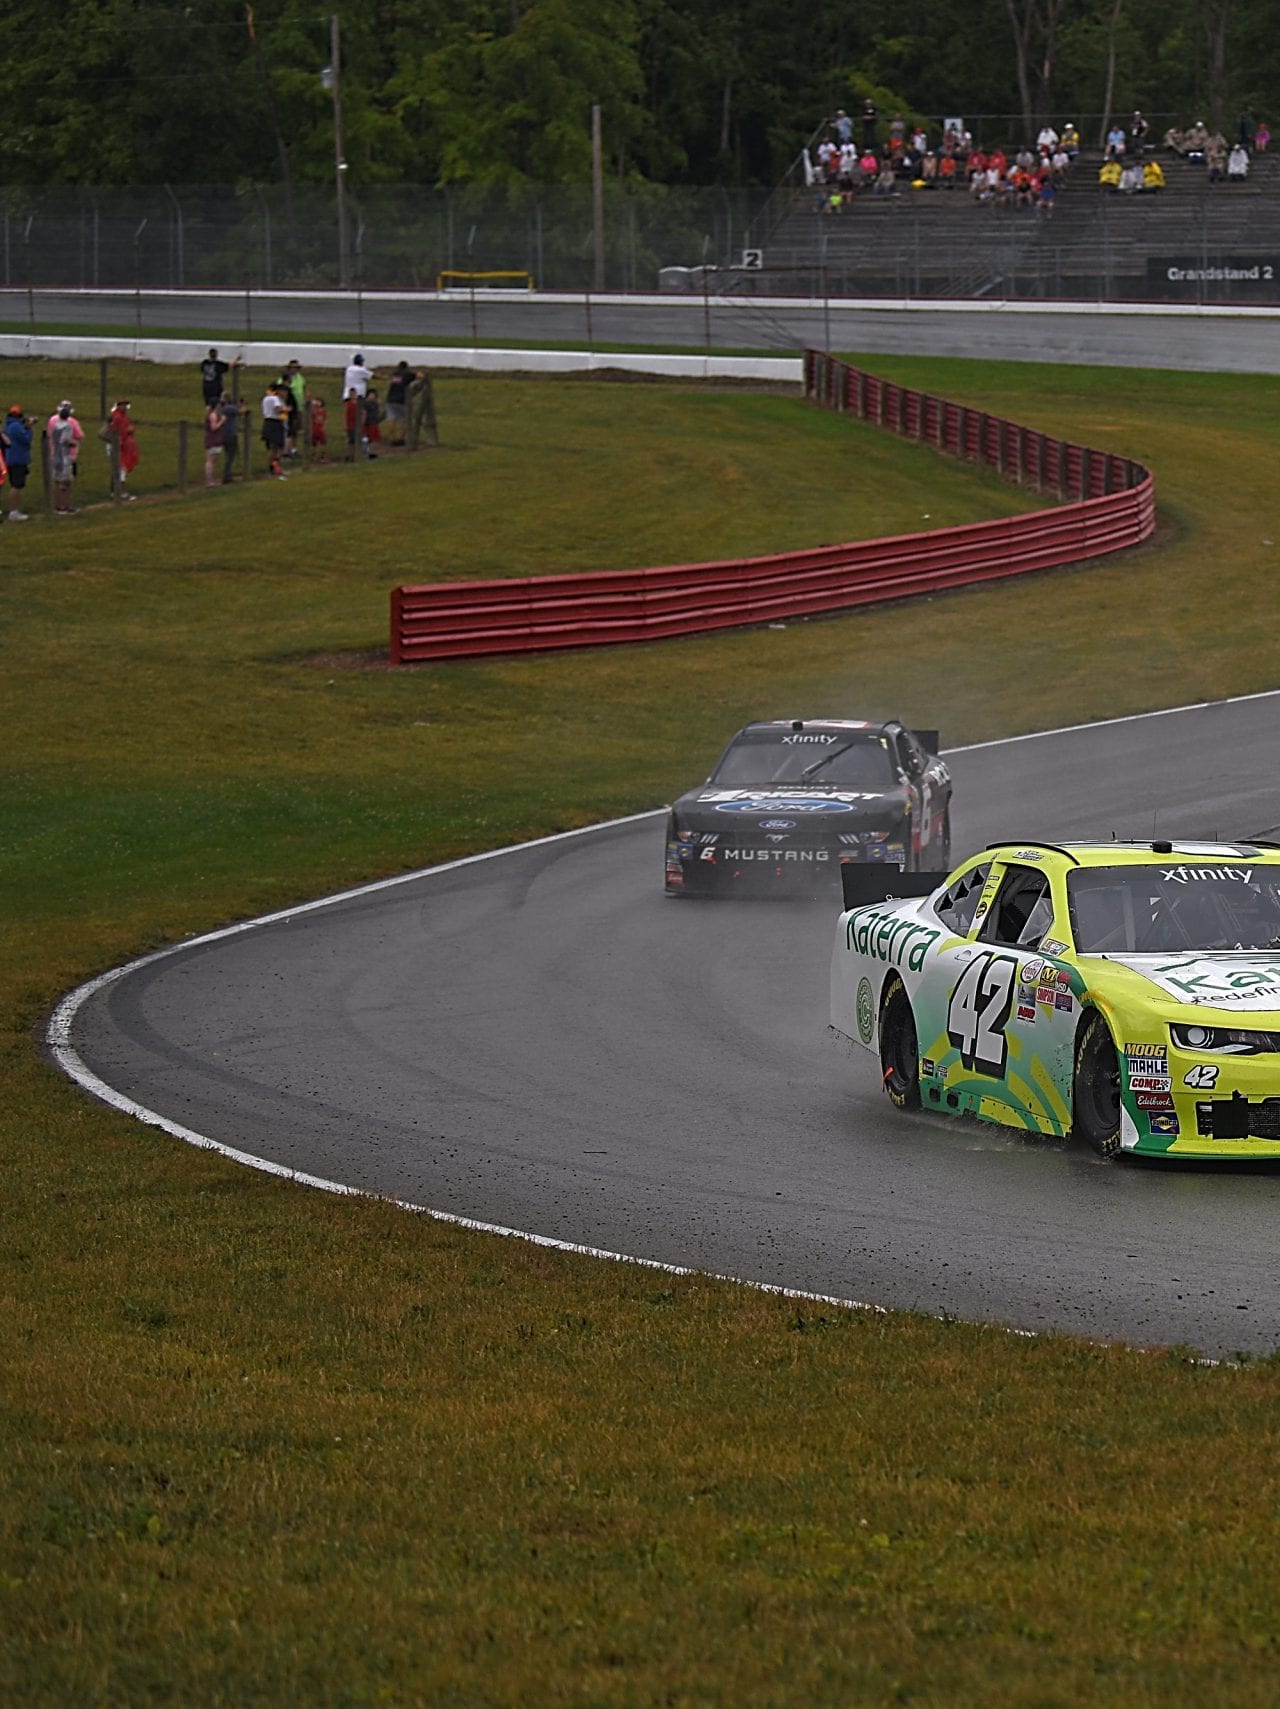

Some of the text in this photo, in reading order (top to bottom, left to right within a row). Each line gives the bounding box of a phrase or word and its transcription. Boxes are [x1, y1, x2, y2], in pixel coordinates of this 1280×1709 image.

[747, 252, 759, 267] 2
[1167, 266, 1274, 280] Grandstand 2
[782, 734, 838, 744] xfinity
[741, 802, 827, 812] Ford
[700, 847, 715, 860] 6
[725, 849, 829, 861] MUSTANG
[1160, 866, 1252, 884] xfinity
[847, 905, 941, 972] Katerra
[947, 950, 1018, 1078] 42
[1126, 1044, 1165, 1056] MOOG
[1129, 1061, 1168, 1073] MAHLE
[1184, 1064, 1219, 1089] 42
[1131, 1078, 1160, 1088] COMP
[1137, 1095, 1173, 1106] Edelbrock
[1151, 1118, 1178, 1127] SUNOCO
